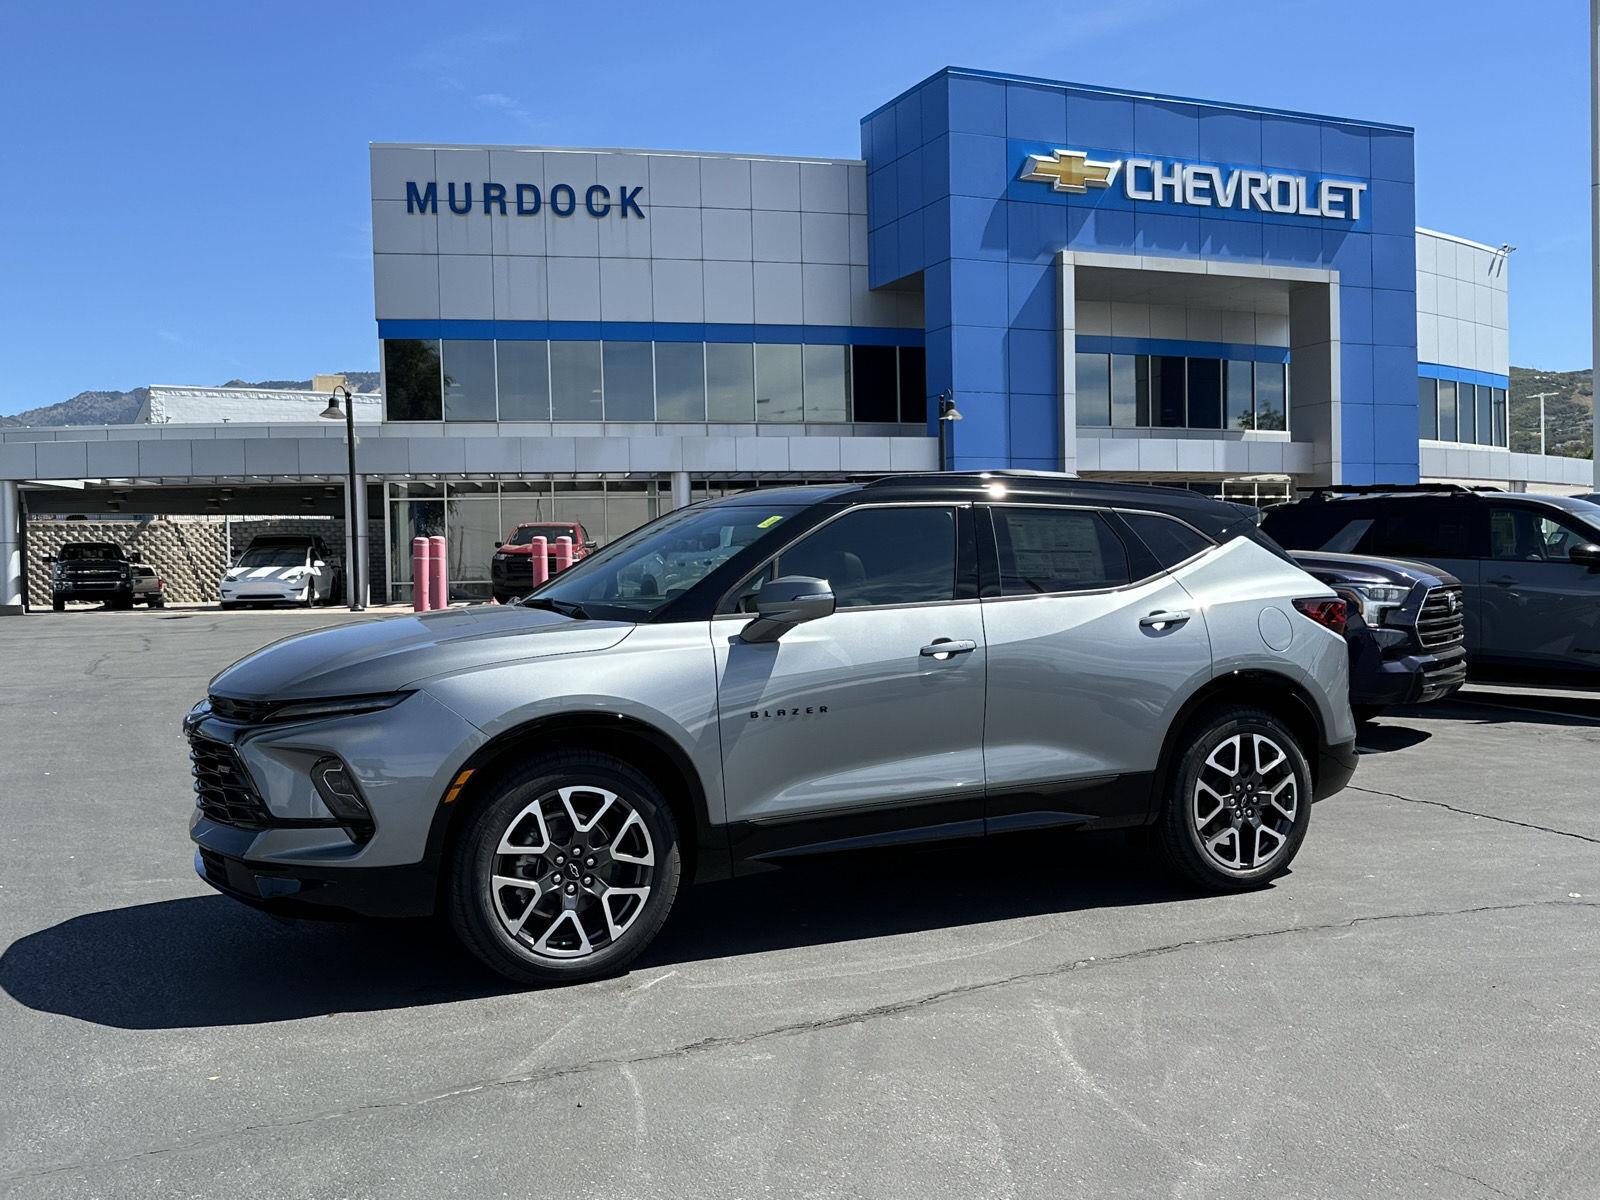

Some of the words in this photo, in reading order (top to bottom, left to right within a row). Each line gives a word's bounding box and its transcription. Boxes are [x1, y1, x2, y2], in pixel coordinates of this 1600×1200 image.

[405, 181, 646, 219] MURDOCK
[1125, 158, 1368, 220] CHEVROLET
[750, 705, 829, 719] BLAZER
